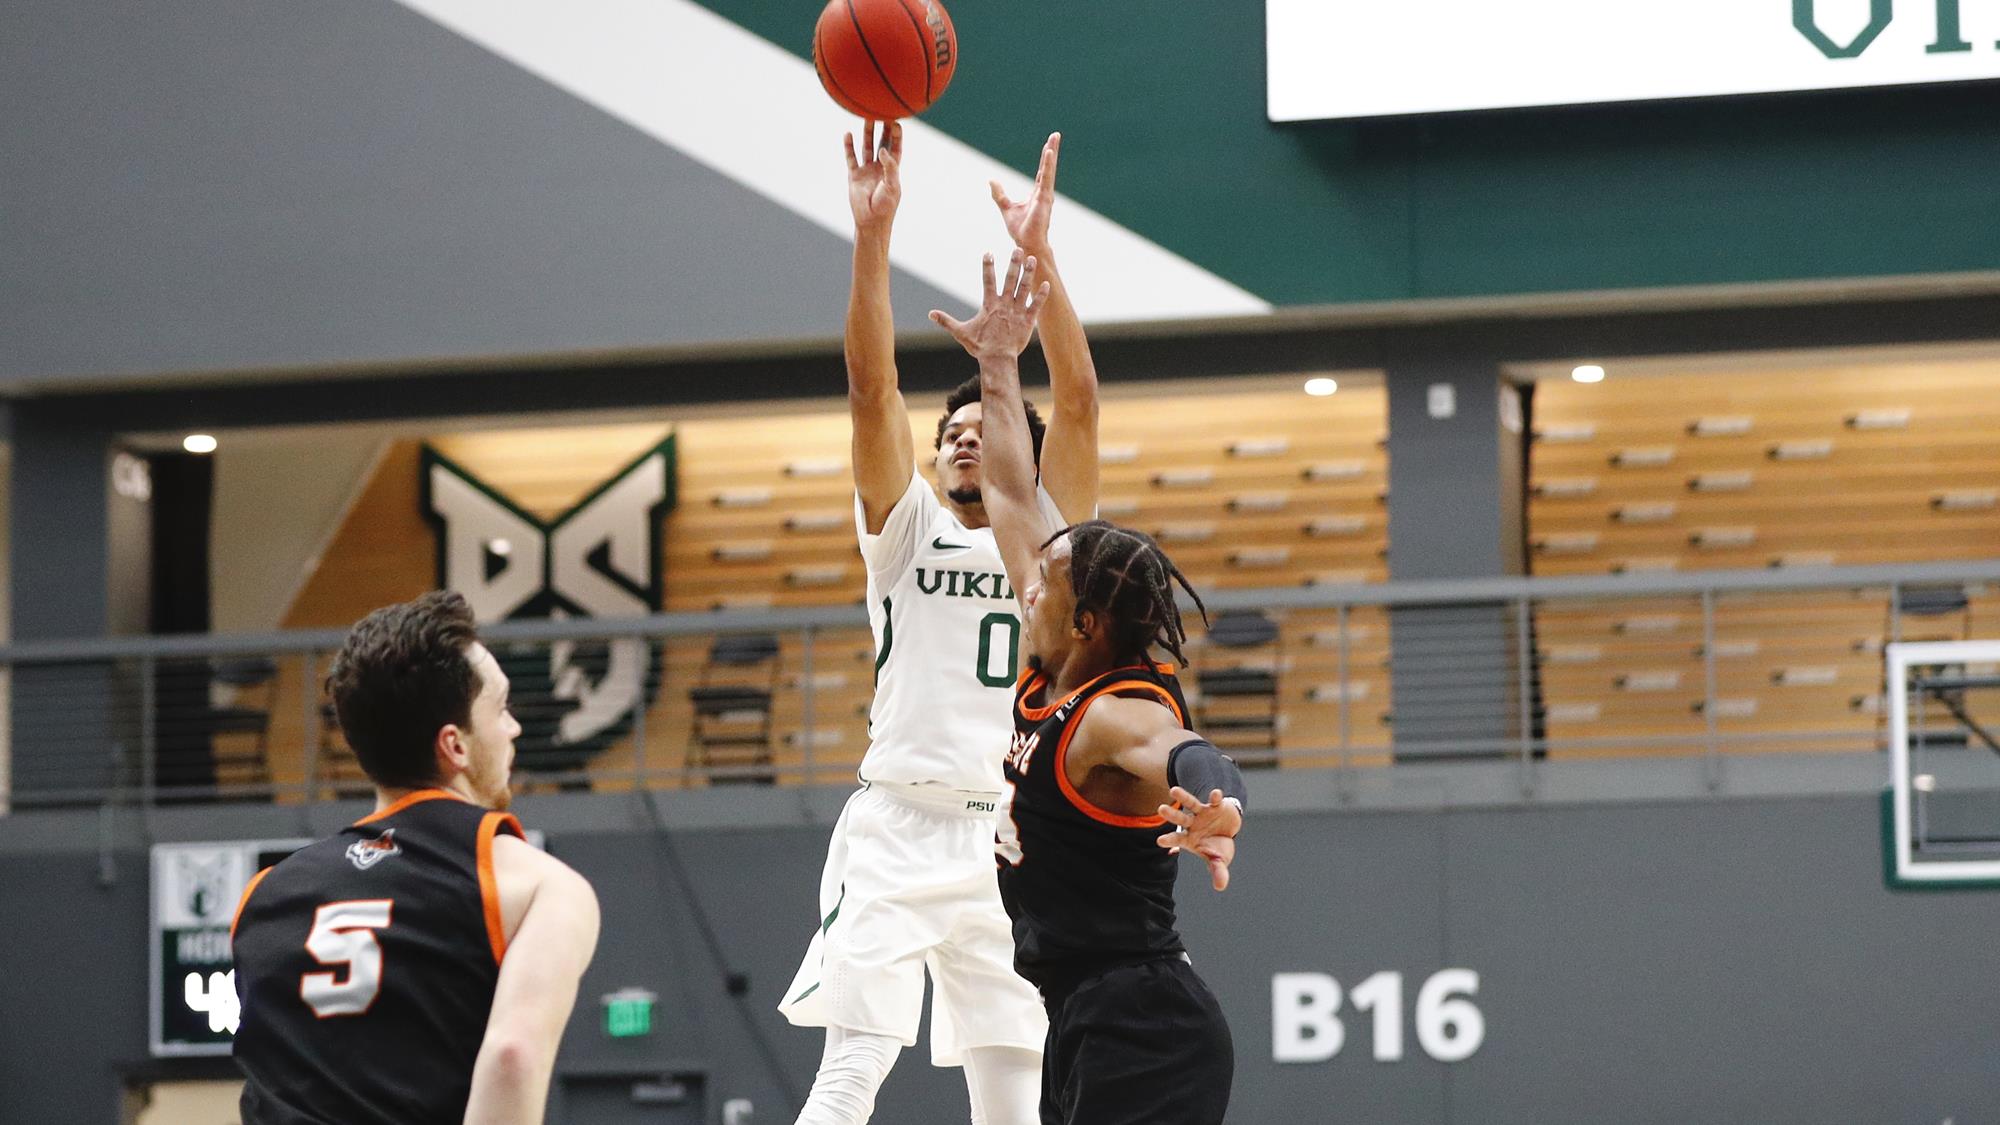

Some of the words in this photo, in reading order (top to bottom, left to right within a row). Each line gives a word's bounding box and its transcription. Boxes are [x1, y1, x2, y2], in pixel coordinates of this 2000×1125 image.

[976, 612, 1021, 689] 0
[966, 800, 996, 813] PSU
[299, 898, 394, 1019] 5
[1271, 967, 1486, 1063] B16
